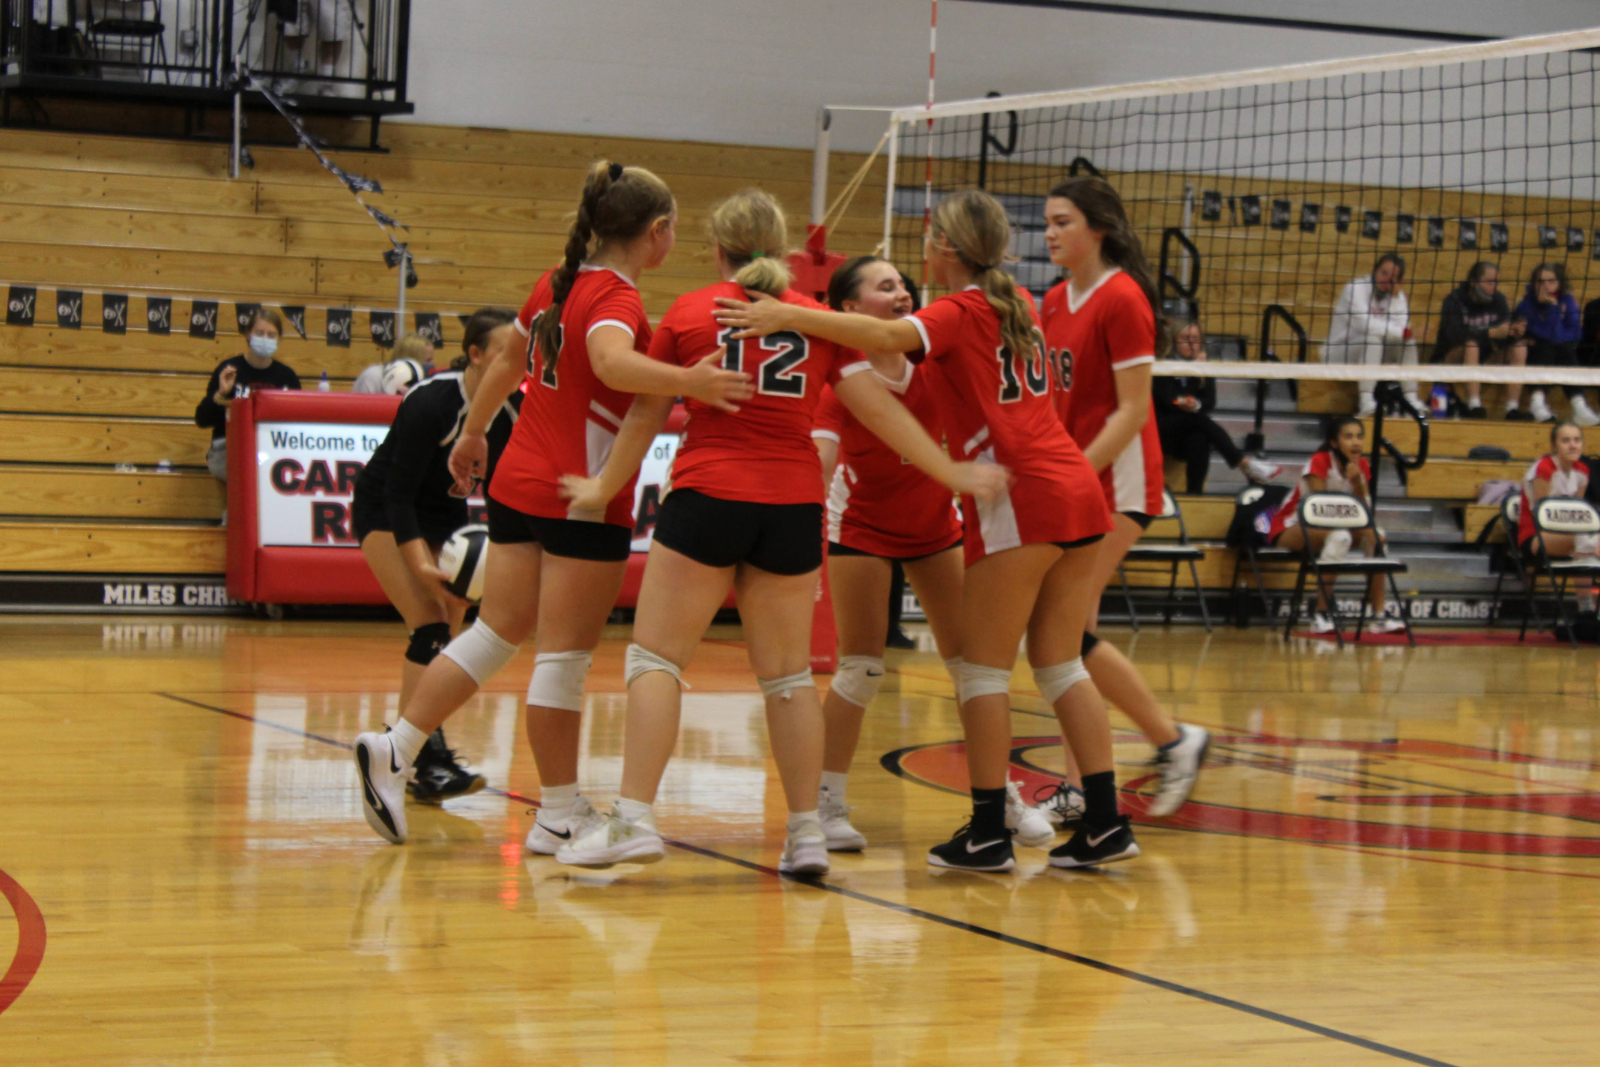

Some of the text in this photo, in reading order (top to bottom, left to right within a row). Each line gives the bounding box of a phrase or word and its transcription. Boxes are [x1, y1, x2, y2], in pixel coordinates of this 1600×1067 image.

[716, 326, 809, 399] 12
[996, 325, 1048, 404] 10
[1049, 347, 1074, 392] 18
[270, 430, 379, 451] Welcome to
[654, 443, 670, 460] of
[270, 458, 366, 496] CAR
[1310, 503, 1360, 518] RAIDERS
[1545, 508, 1594, 523] RAIDERS
[103, 583, 230, 606] MILES CHR
[1410, 600, 1433, 619] OF
